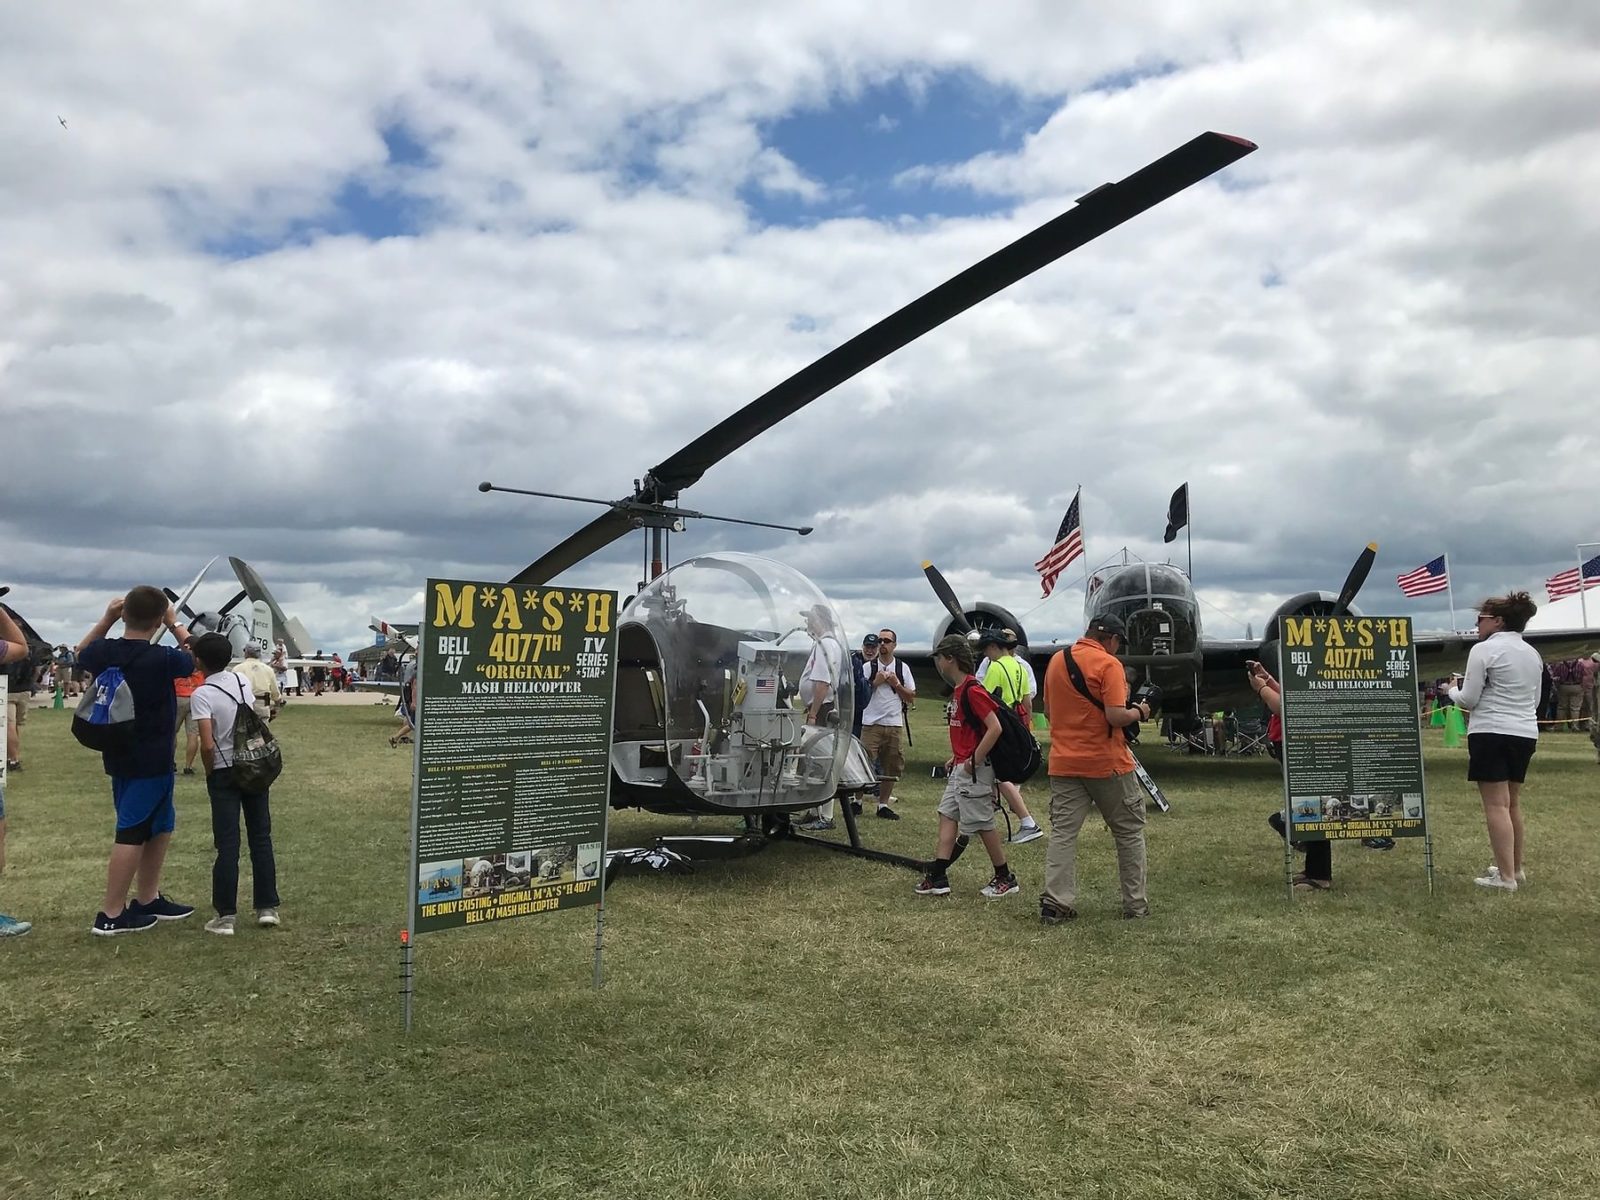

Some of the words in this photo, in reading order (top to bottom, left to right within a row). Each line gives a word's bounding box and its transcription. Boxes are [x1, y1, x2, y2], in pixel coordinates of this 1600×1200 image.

[438, 636, 470, 655] BELL
[489, 632, 562, 662] 4077TH
[584, 638, 606, 653] TV
[576, 653, 608, 666] SERIES
[1291, 652, 1312, 664] BELL
[1325, 648, 1374, 668] 4077TH
[1390, 650, 1406, 660] TV
[444, 656, 463, 674] 47
[1296, 665, 1308, 677] 47
[1386, 661, 1410, 670] SERIES
[476, 665, 570, 680] “ORIGINAL”
[582, 667, 600, 678] STAR
[1317, 669, 1382, 679] “ORIGINAL”
[462, 682, 500, 694] MASH
[504, 682, 581, 693] HELICOPTER
[1309, 681, 1334, 689] MASH
[1337, 681, 1392, 689] HELICOPTER
[1295, 823, 1305, 831] THE
[1305, 823, 1319, 831] ONLY
[1320, 822, 1343, 830] EXISTING
[1325, 830, 1338, 839] BELL
[1339, 830, 1346, 838] 47
[1347, 830, 1361, 838] MASH
[1362, 829, 1392, 838] HELICOPTER
[422, 905, 437, 917] THE
[437, 902, 458, 914] ONLY
[459, 896, 492, 912] EXISTING
[499, 890, 532, 905] ORIGINAL
[466, 910, 484, 923] BELL
[486, 908, 495, 920] 47
[496, 905, 518, 918] MASH
[518, 898, 559, 915] HELICOPTER
